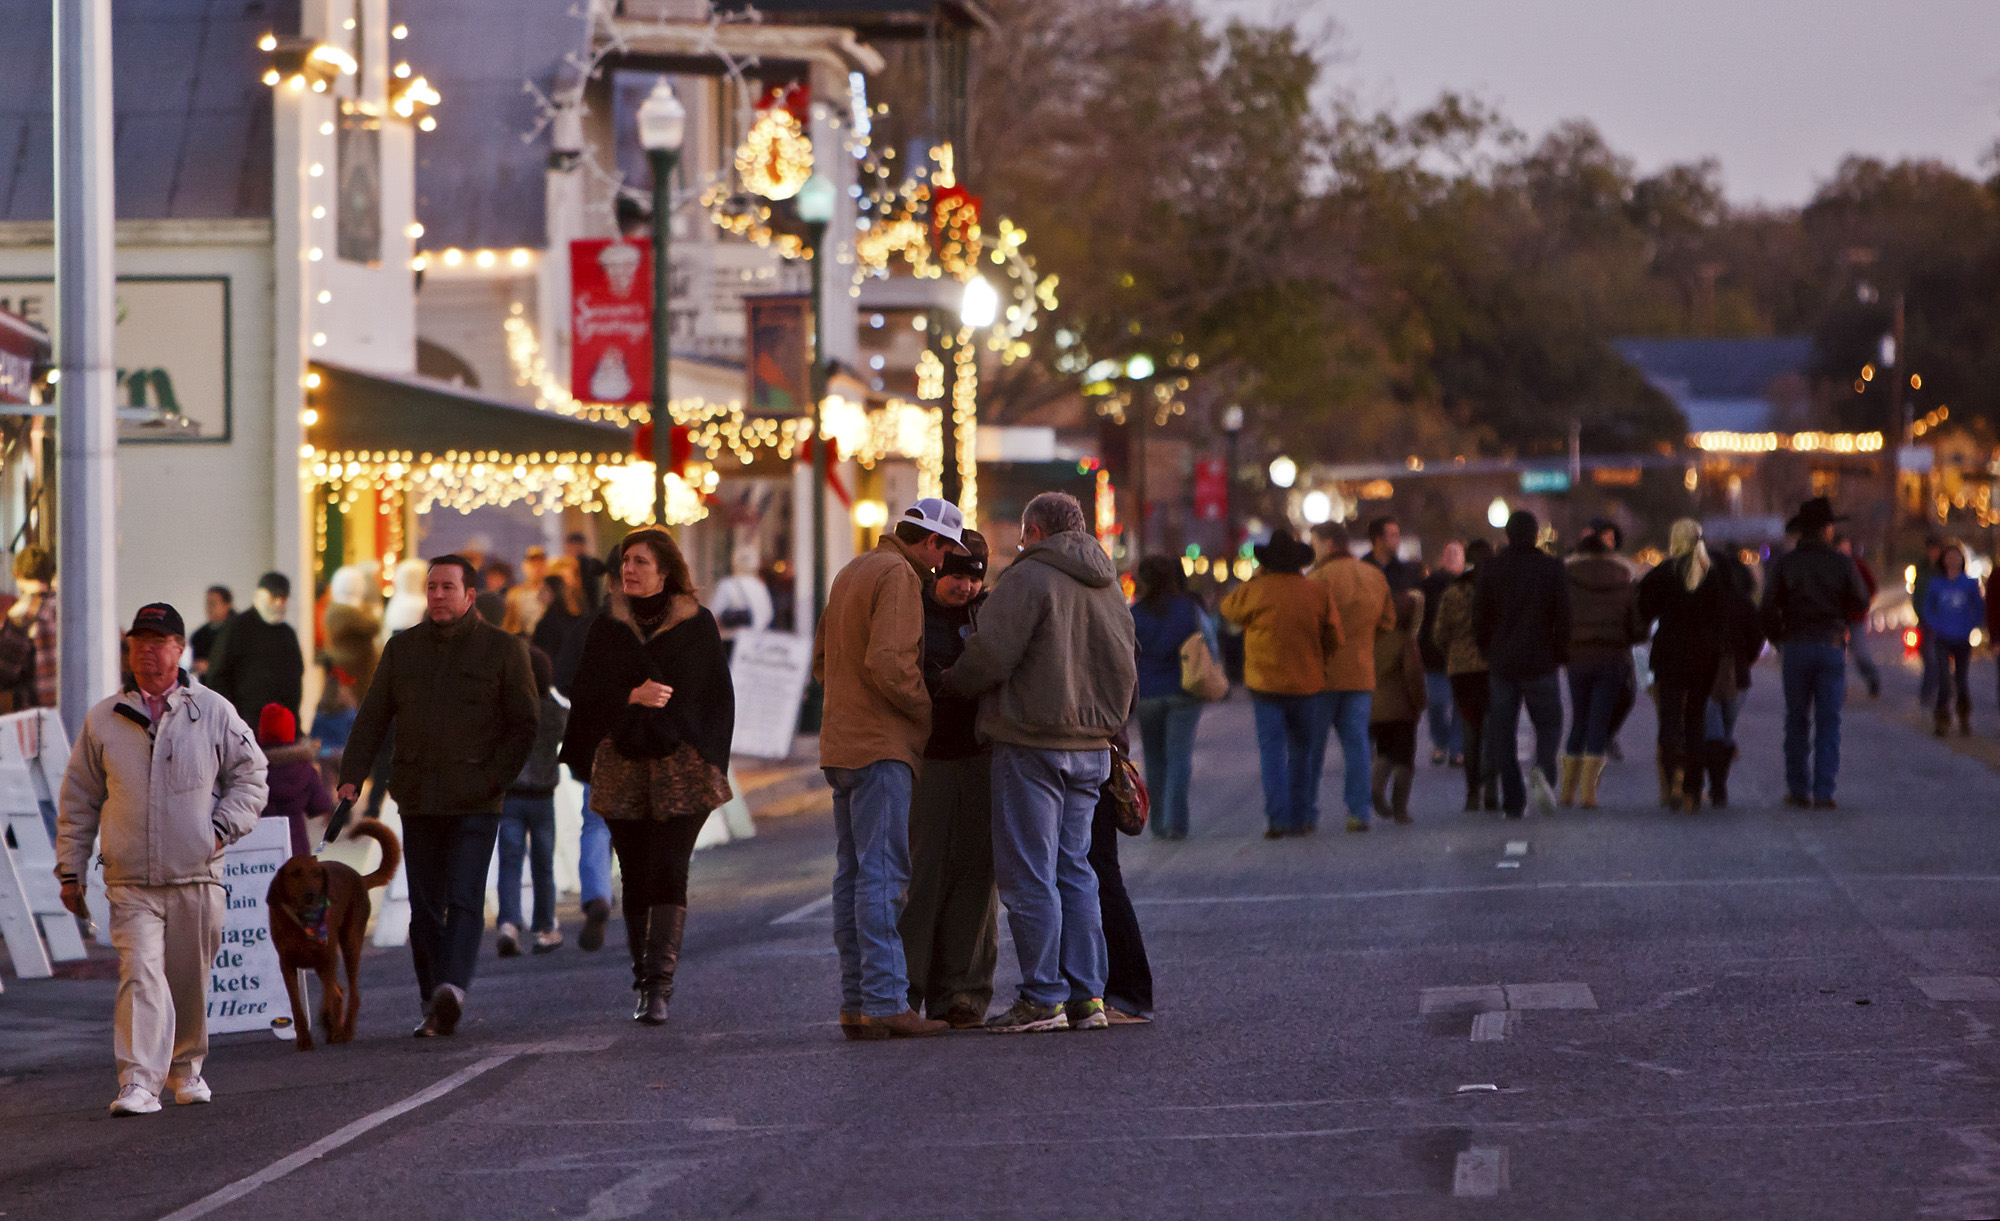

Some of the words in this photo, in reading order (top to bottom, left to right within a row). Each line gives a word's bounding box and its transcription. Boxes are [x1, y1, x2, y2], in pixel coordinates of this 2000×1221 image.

[222, 863, 276, 876] ickens
[226, 895, 257, 910] ain
[221, 926, 267, 948] iage
[212, 950, 243, 969] de
[208, 974, 260, 993] kets
[220, 1000, 268, 1017] Here
